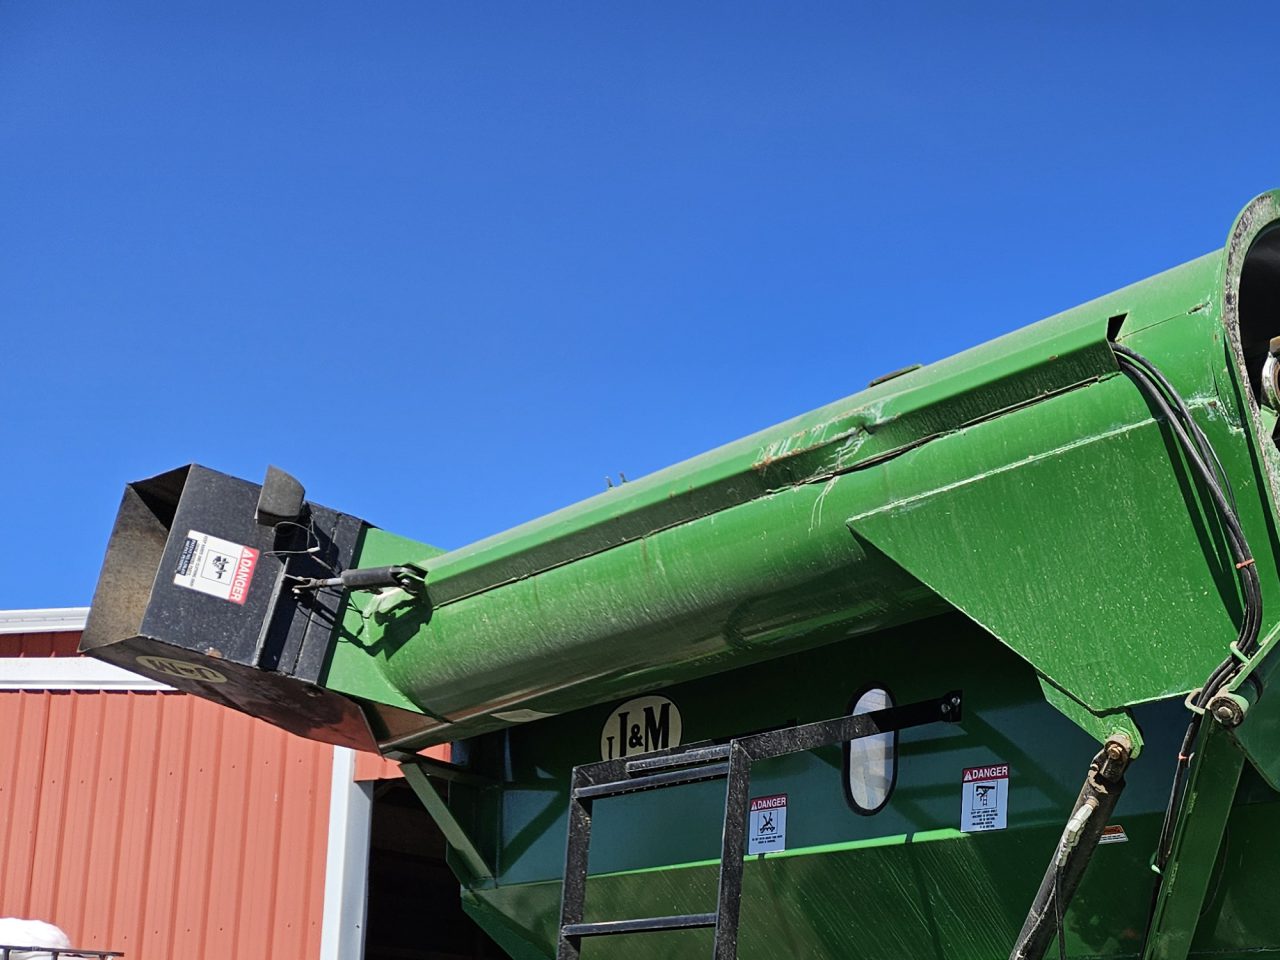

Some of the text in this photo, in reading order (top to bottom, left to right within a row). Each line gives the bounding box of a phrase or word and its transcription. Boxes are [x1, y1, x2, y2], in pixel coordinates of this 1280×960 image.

[231, 558, 253, 601] DANGER
[973, 766, 1008, 779] DANGER
[757, 797, 786, 809] DANGER
